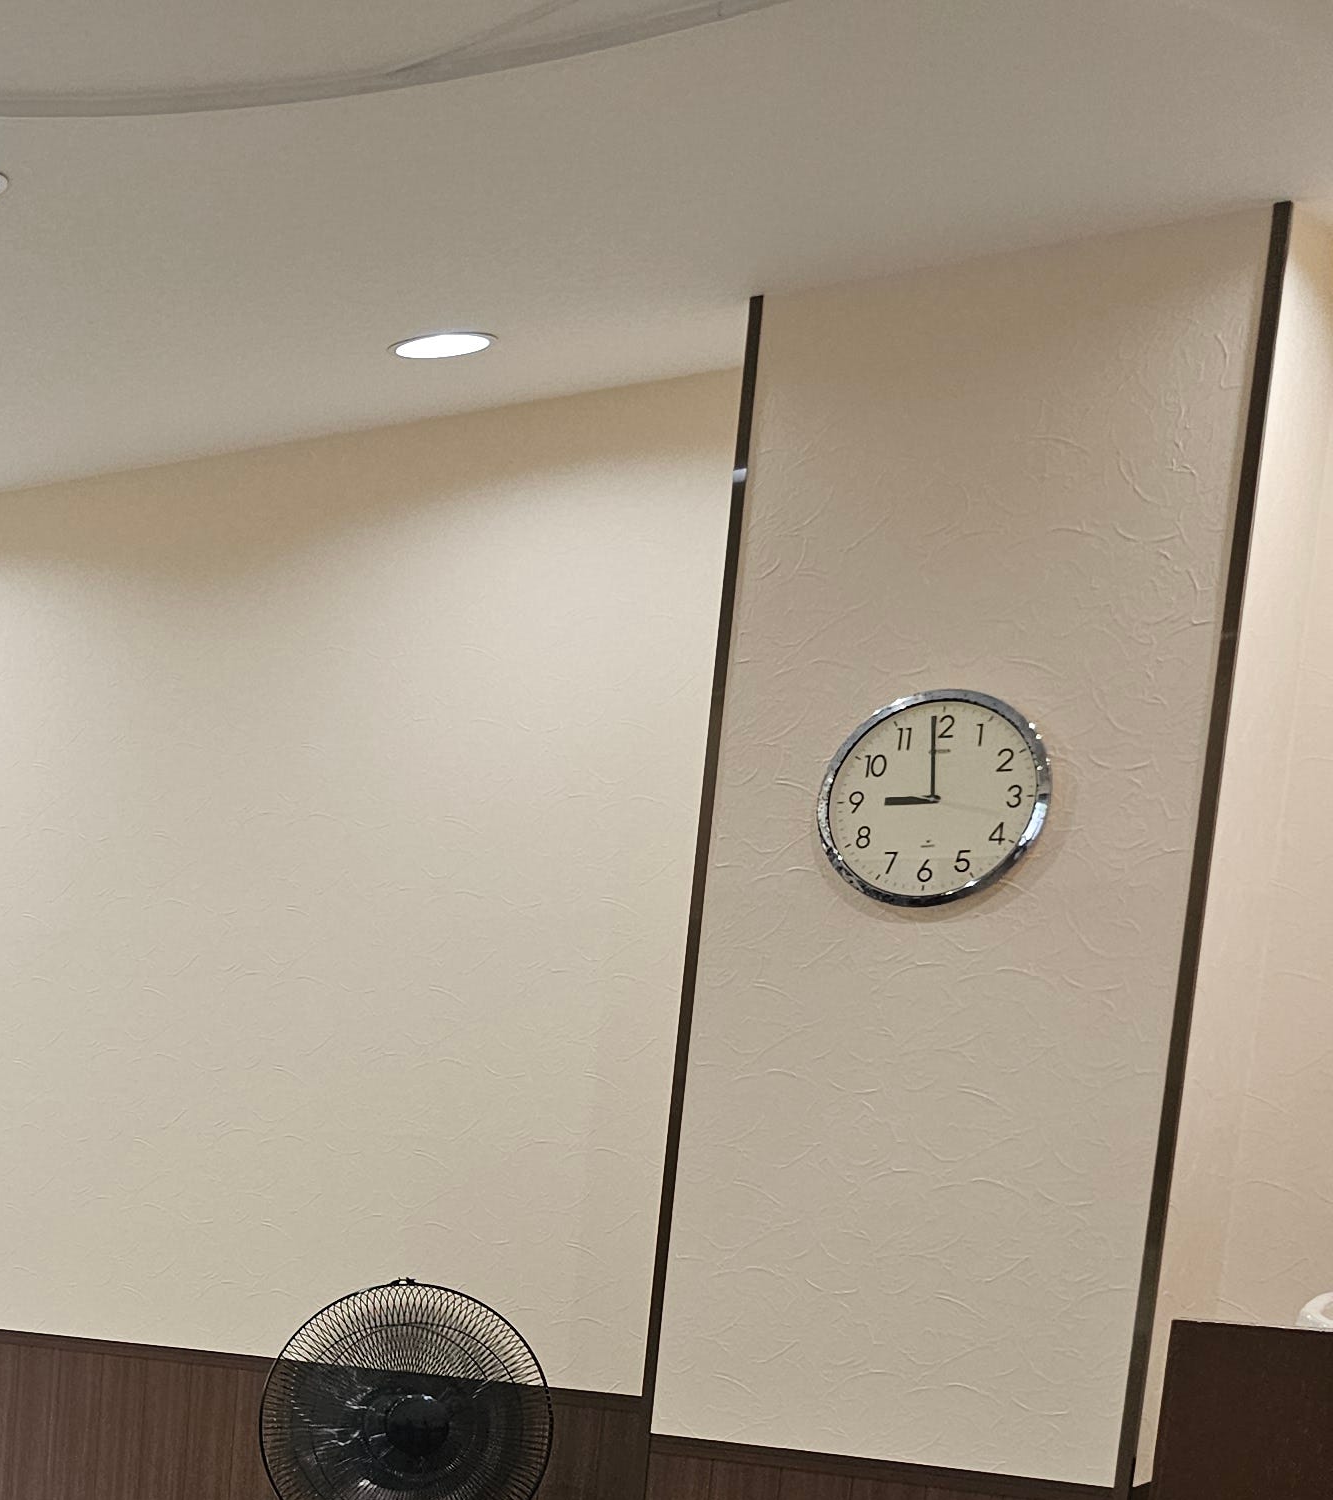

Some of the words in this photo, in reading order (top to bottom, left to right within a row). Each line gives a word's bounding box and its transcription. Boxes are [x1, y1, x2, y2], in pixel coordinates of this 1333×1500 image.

[897, 727, 913, 751] 11
[976, 723, 984, 747] 1
[864, 754, 887, 778] 10
[996, 748, 1014, 772] 2
[849, 791, 864, 814] 9
[1006, 785, 1023, 808] 3
[856, 826, 871, 849] 8
[988, 822, 1005, 845] 4
[884, 852, 898, 875] 7
[917, 859, 933, 882] 6
[954, 850, 971, 873] 5
